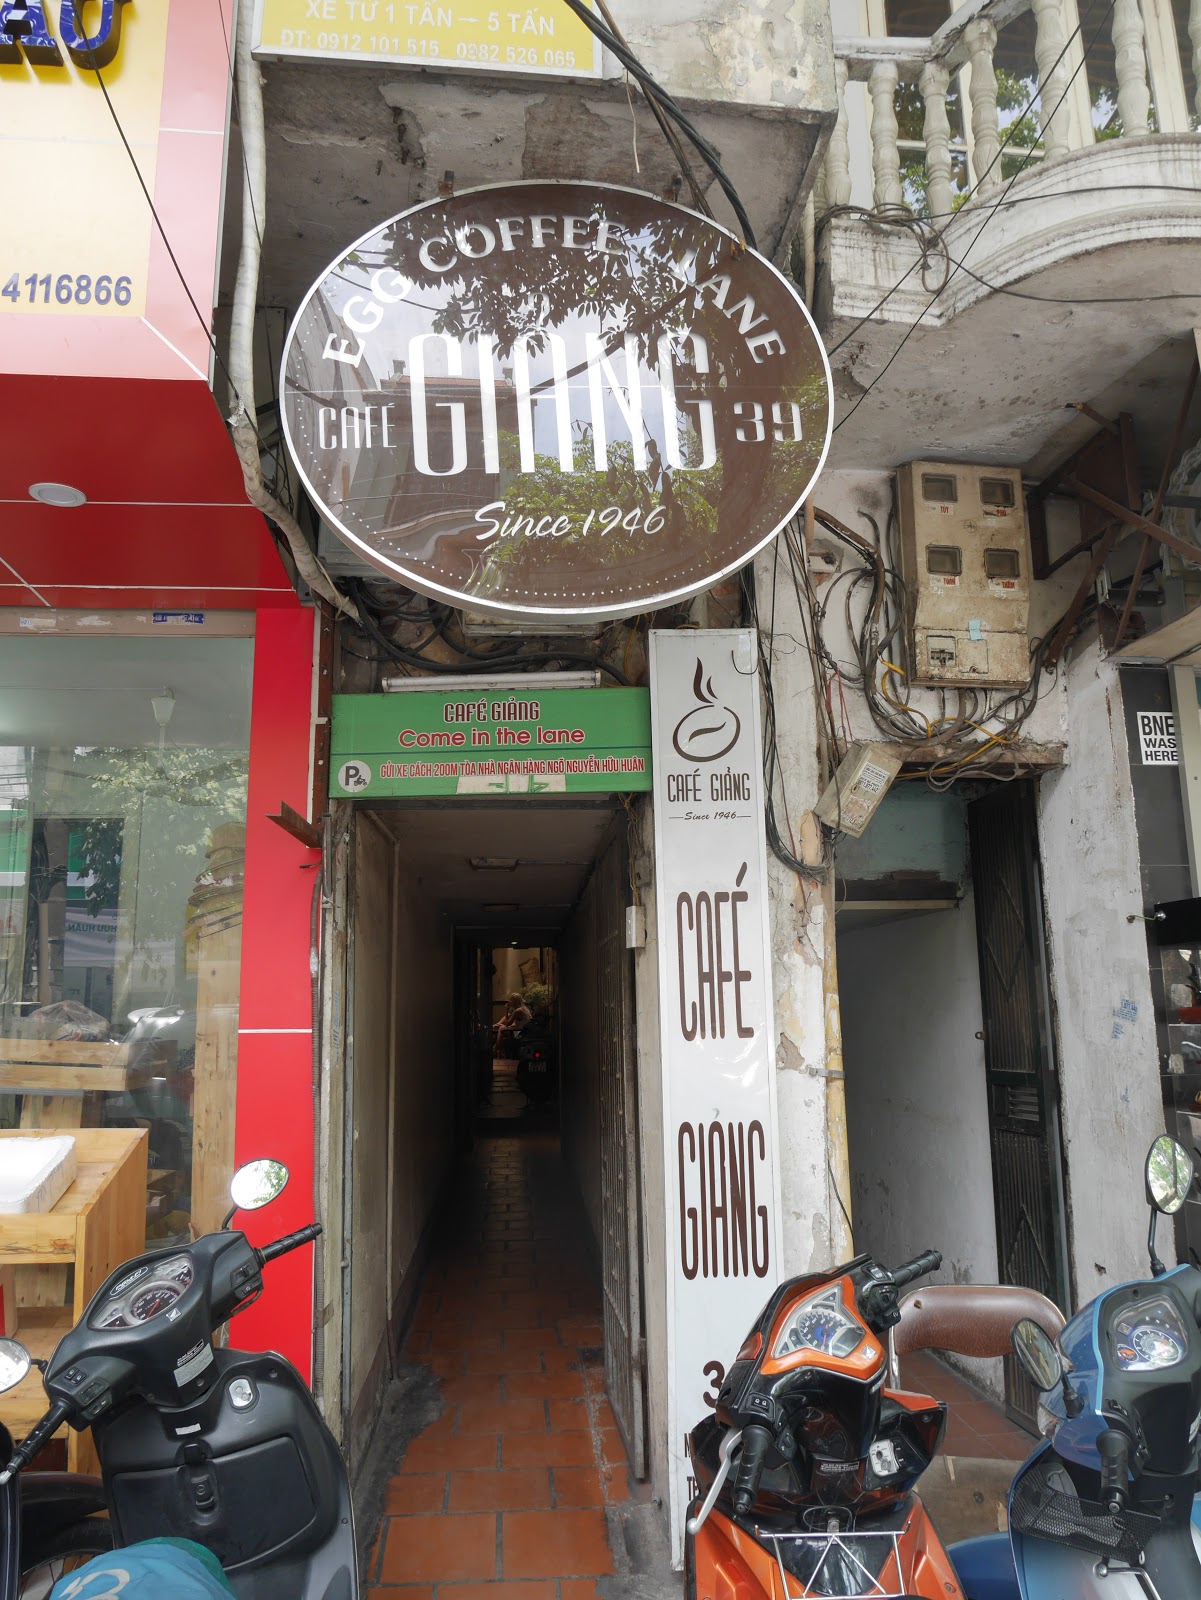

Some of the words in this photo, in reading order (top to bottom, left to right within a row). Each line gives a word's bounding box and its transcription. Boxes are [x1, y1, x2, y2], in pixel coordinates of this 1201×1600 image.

[385, 4, 395, 24] 1
[487, 11, 500, 32] 5
[507, 7, 555, 37] TẤN
[317, 32, 362, 51] 0912
[370, 35, 400, 54] 101
[407, 38, 440, 57] 515
[456, 42, 499, 61] 0982
[506, 46, 538, 64] 526
[544, 49, 576, 68] 065
[1, 272, 132, 306] 4116866
[321, 267, 412, 369] EGG
[418, 215, 627, 272] COFFEE
[670, 249, 787, 364] LANE
[318, 404, 397, 449] CAFÉ
[733, 401, 803, 442] 39
[474, 501, 571, 539] Since
[582, 505, 666, 537] 1946
[444, 698, 487, 723] CAFÉ
[491, 696, 541, 721] GIẢNG
[398, 729, 466, 748] Come
[471, 728, 490, 746] in
[497, 727, 532, 745] the
[537, 726, 585, 744] lane
[1140, 715, 1175, 736] BNE
[1143, 737, 1177, 749] WAS
[1145, 750, 1179, 762] HERE
[345, 766, 360, 786] P
[396, 764, 408, 777] XE
[409, 761, 432, 777] CÁCH
[434, 763, 458, 777] 200M
[460, 760, 477, 776] TÒA
[478, 759, 496, 775] NHÀ
[498, 759, 520, 775] NGÂN
[522, 758, 546, 774] HÀNG
[547, 757, 565, 774] NGÕ
[566, 754, 600, 773] NGUYỄN
[602, 756, 619, 772] HỮU
[621, 755, 645, 772] HUÂN
[667, 768, 702, 802] CAFÉ
[710, 767, 751, 801] GIẢNG
[684, 811, 710, 820] Since
[713, 811, 737, 820] 1946
[677, 861, 754, 1042] CAFÉ
